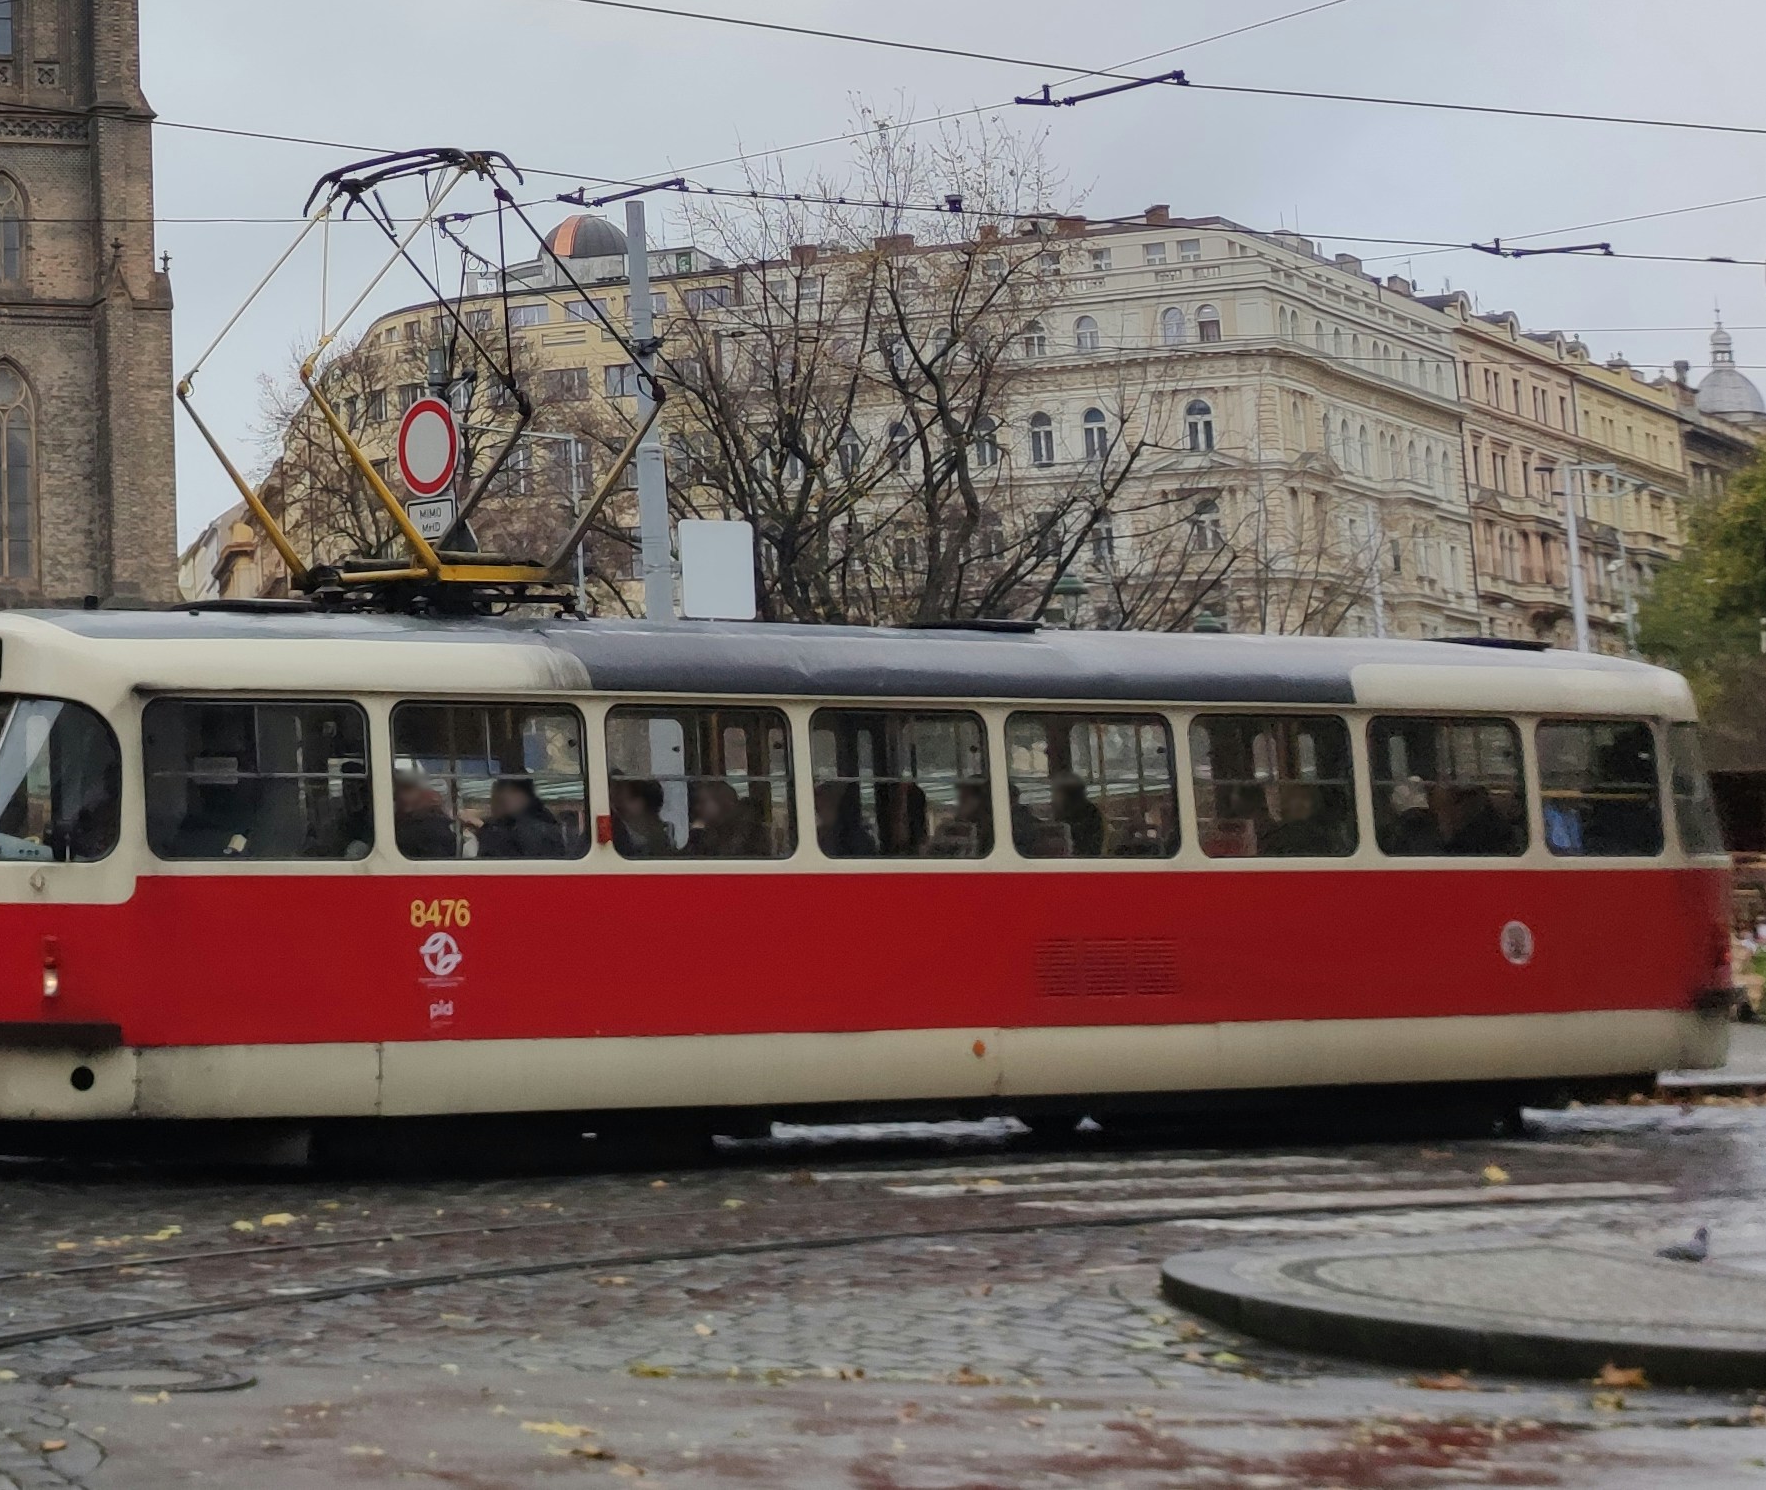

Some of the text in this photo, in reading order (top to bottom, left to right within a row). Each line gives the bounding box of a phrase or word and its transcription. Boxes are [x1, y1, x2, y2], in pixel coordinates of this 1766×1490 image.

[419, 507, 441, 519] MIMO
[422, 522, 441, 533] MHD
[410, 898, 471, 928] 8476
[429, 999, 454, 1020] pid
